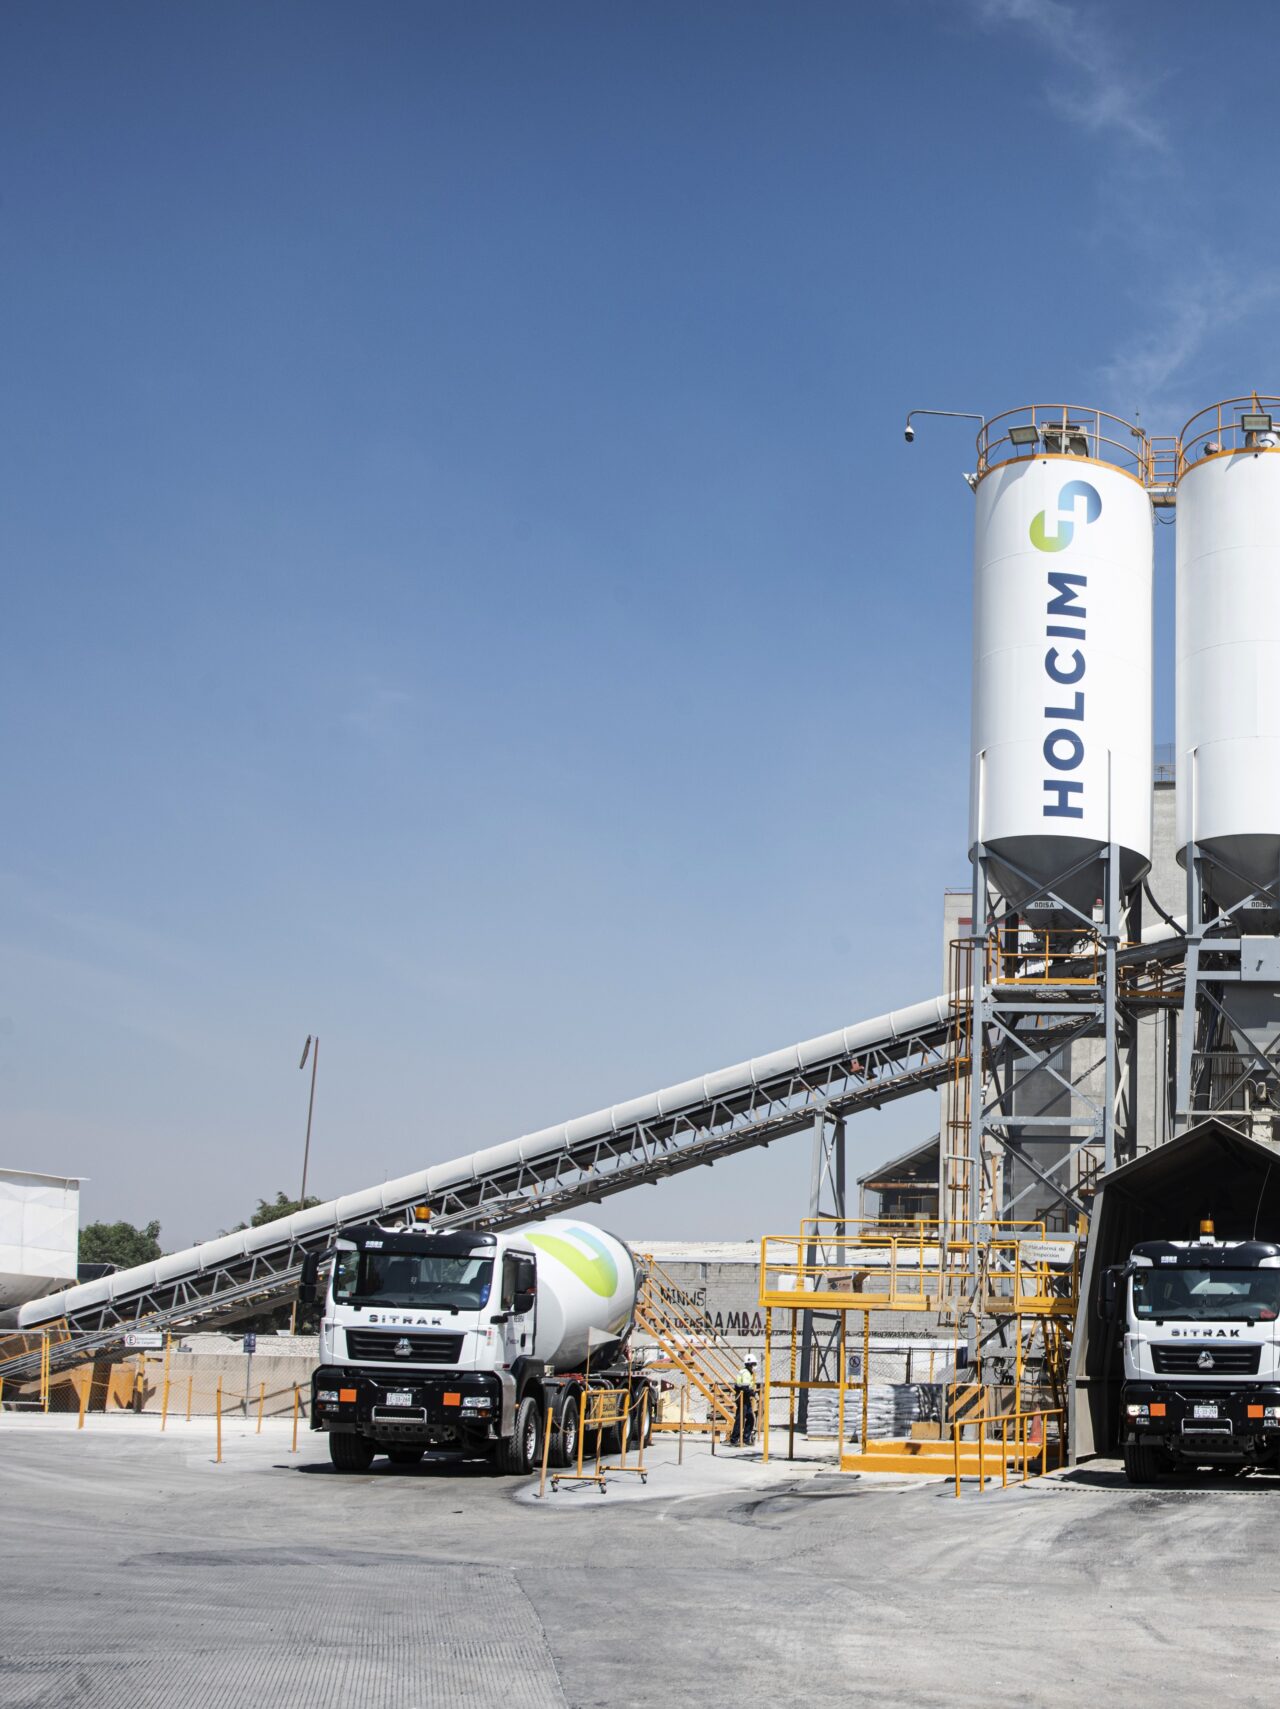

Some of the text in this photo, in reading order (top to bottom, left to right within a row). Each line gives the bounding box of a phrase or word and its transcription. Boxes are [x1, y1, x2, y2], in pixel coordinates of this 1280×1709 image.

[1044, 573, 1087, 819] HOLCIM
[369, 1314, 442, 1325] SITRAK
[1171, 1329, 1240, 1337] SITRAK
